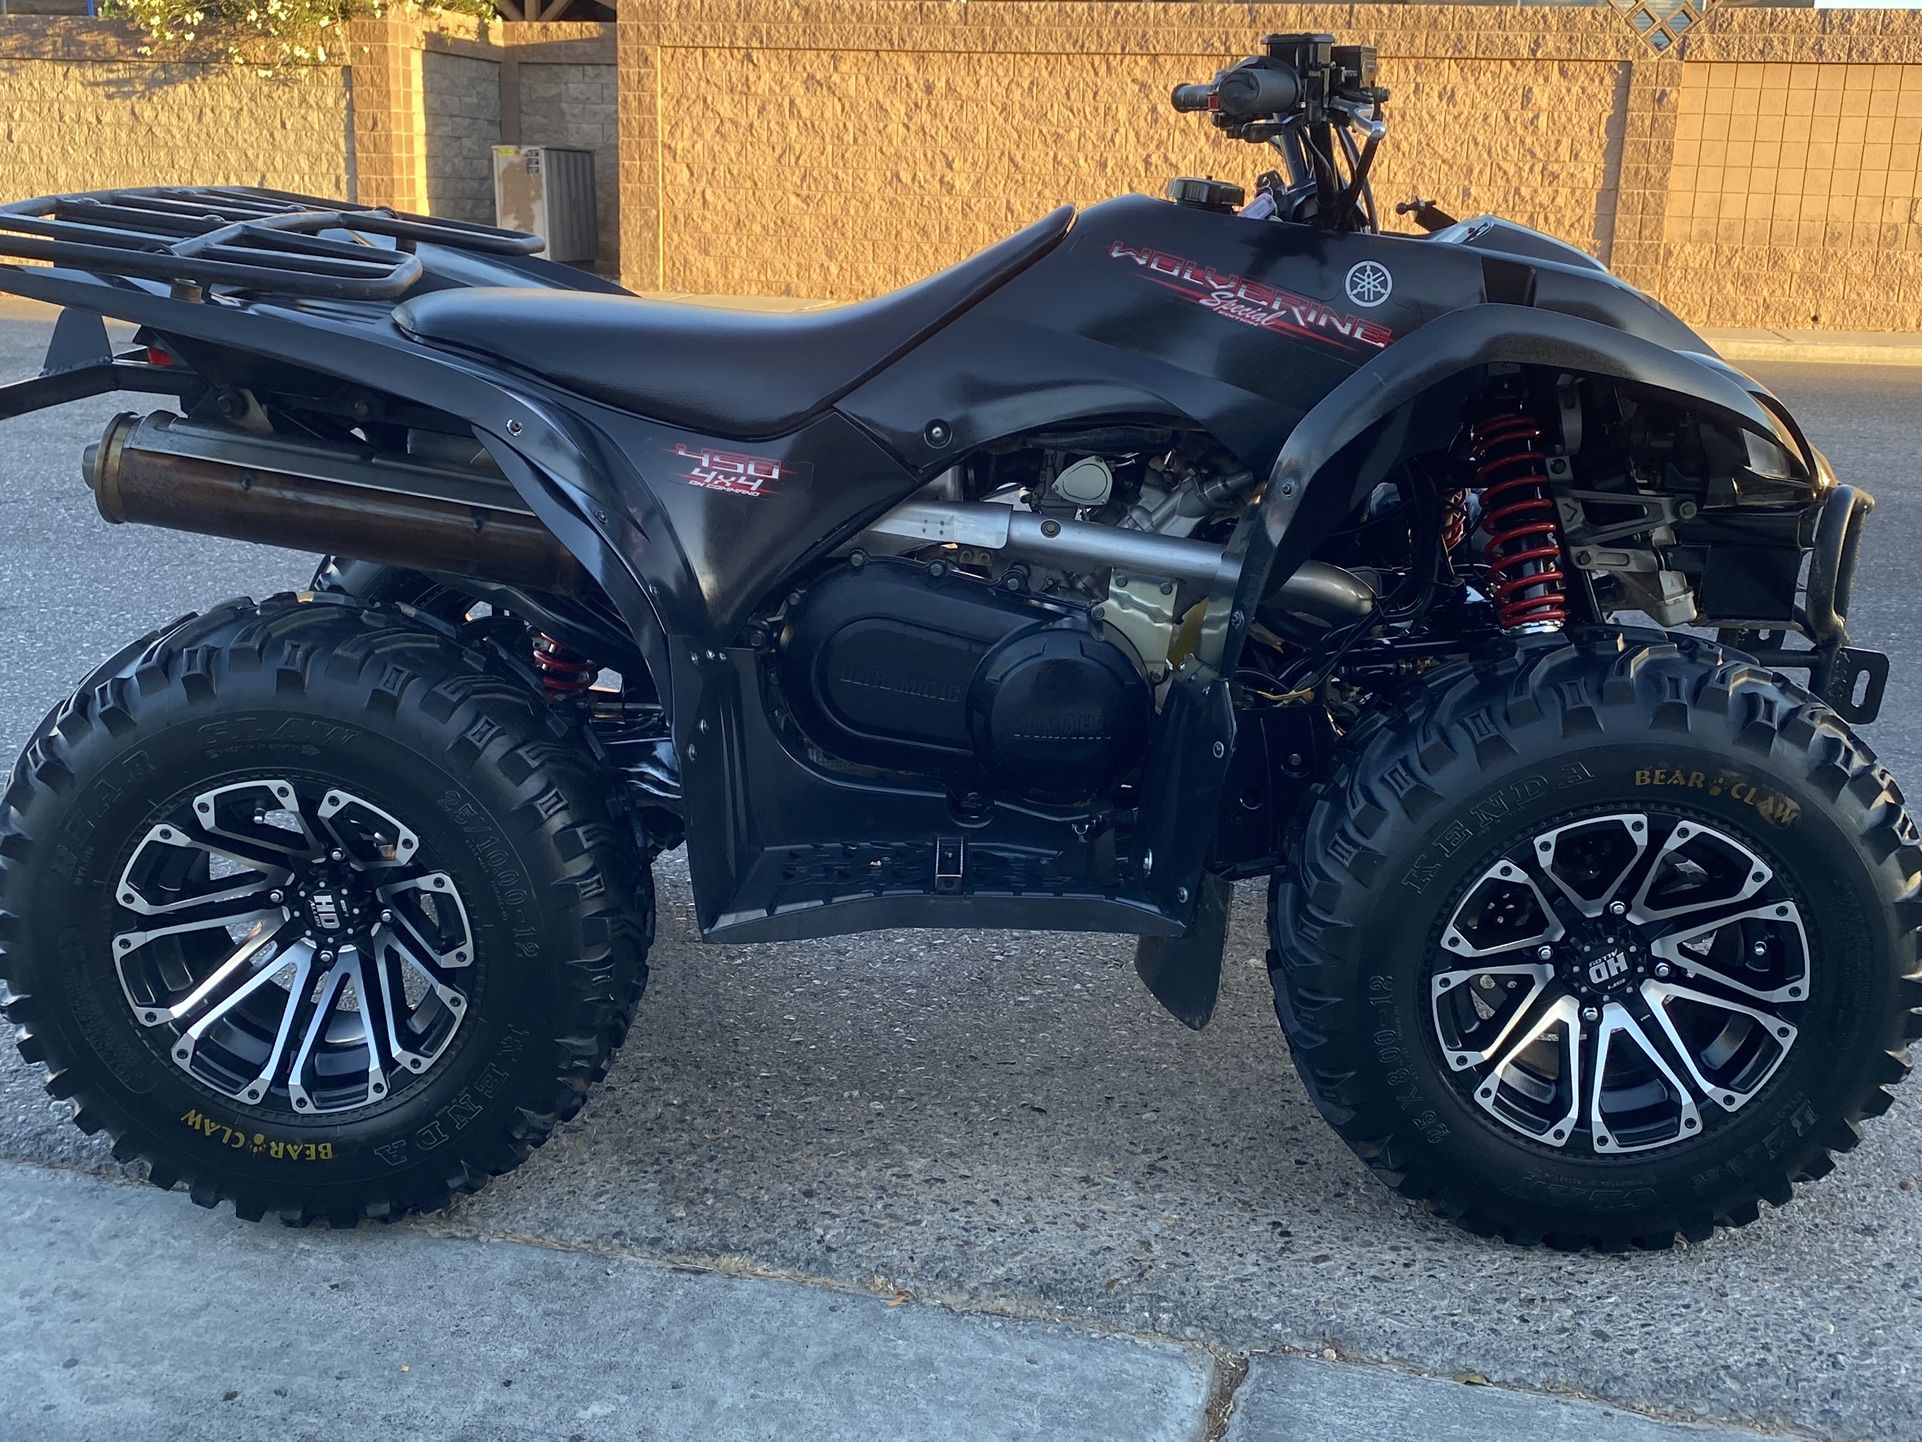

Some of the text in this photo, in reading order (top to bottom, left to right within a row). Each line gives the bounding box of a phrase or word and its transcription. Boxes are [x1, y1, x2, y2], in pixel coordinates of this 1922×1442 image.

[1108, 240, 1392, 347] WOLVERINE
[1199, 291, 1287, 326] Special
[675, 443, 781, 480] 450
[1635, 768, 1799, 826] BEAR CLAW
[1401, 761, 1596, 895] KENDA
[313, 894, 341, 930] HD
[1589, 951, 1629, 985] HD
[374, 1023, 530, 1166] KENDA
[180, 1109, 333, 1161] BEAR CLAW
